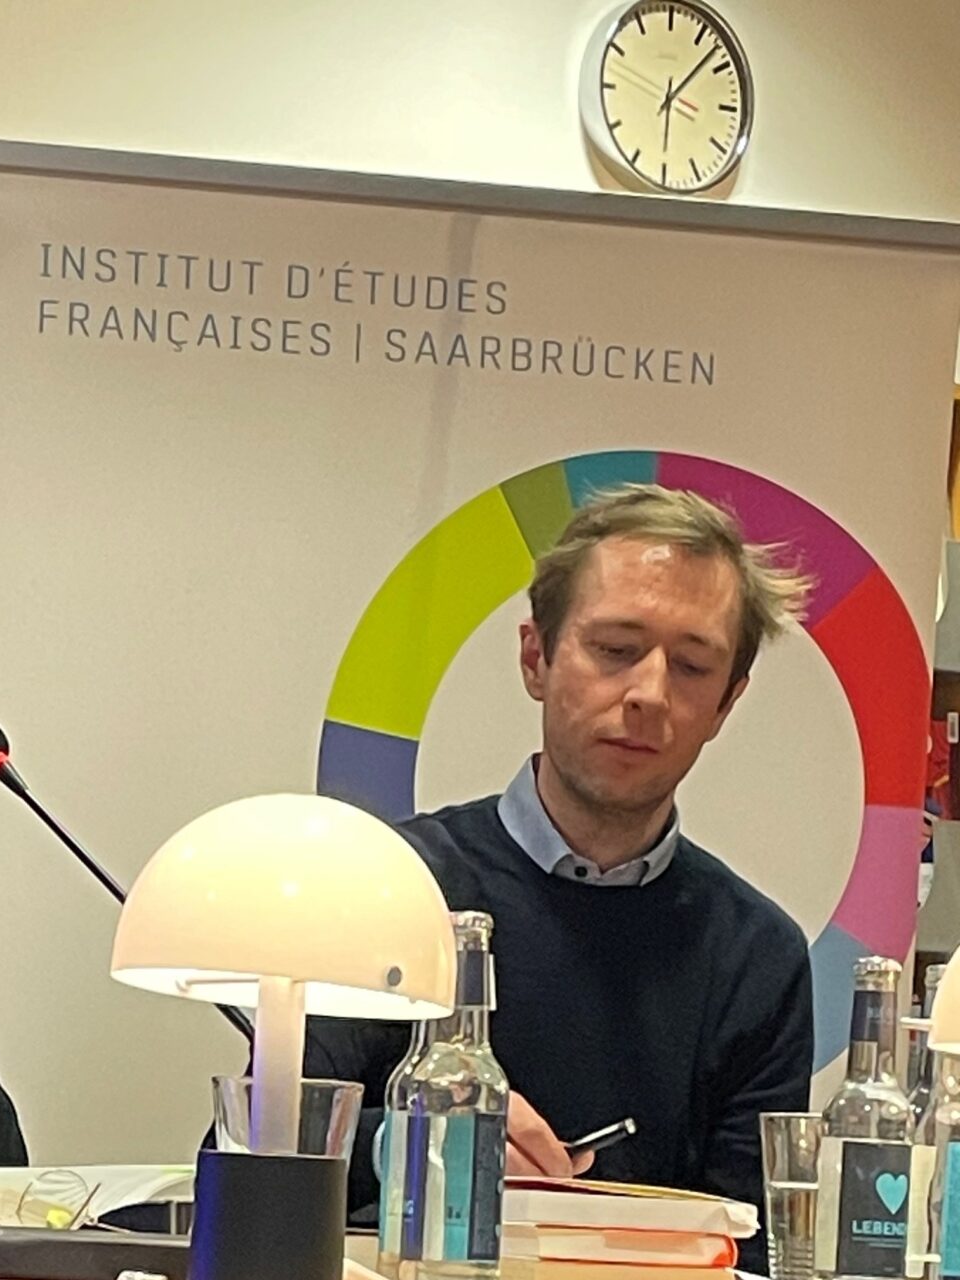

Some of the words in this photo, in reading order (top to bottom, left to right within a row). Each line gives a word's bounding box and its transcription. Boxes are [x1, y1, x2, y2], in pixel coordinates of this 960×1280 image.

[40, 243, 264, 296] INSTITUT
[286, 260, 508, 315] D'ÉTUDES
[38, 299, 332, 357] FRANÇAISES
[384, 328, 716, 386] SAARBRÜCKEN
